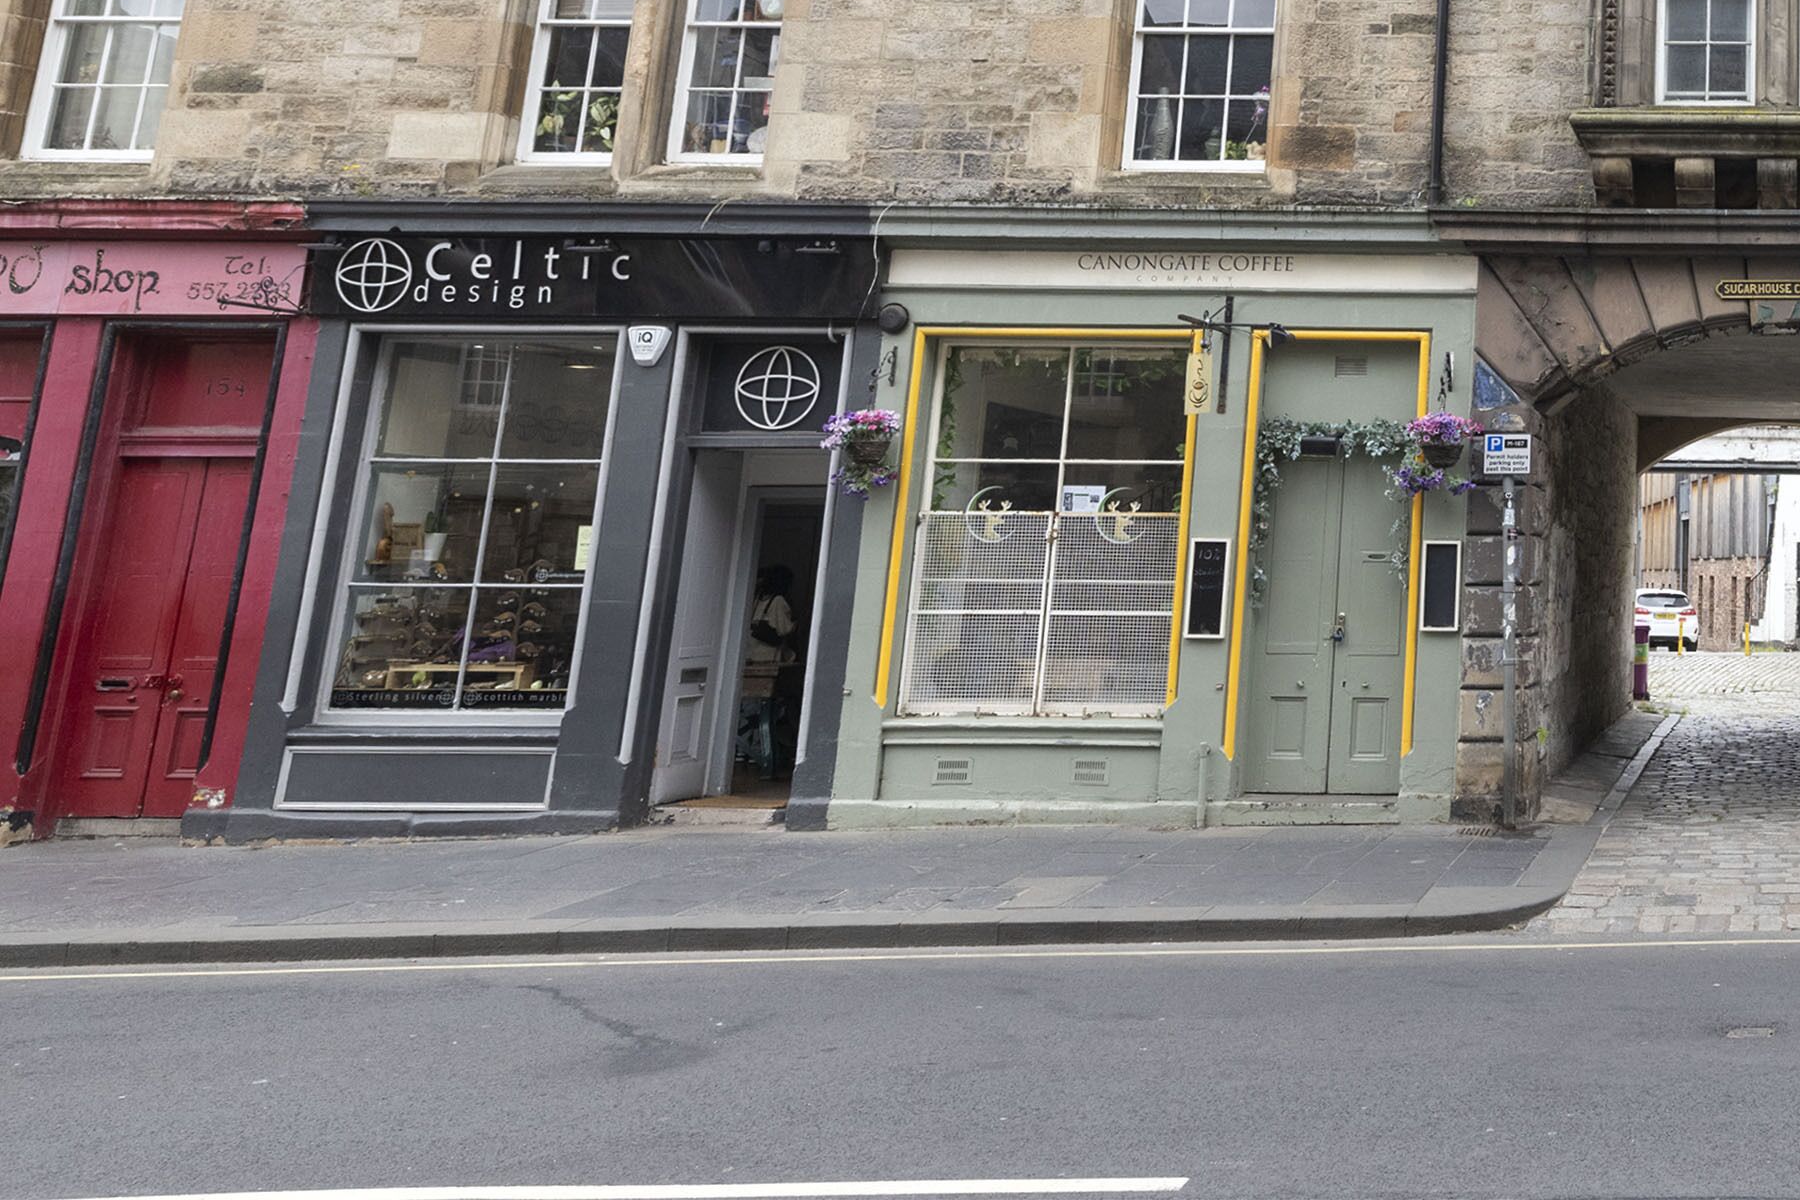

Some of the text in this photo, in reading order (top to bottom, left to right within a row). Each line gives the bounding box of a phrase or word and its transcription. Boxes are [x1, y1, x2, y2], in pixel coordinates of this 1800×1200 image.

[224, 256, 271, 275] Tel:
[425, 240, 630, 281] Celtic
[1078, 254, 1294, 272] CANONGATE COFFEE
[65, 250, 160, 312] shop
[1136, 274, 1234, 283] COMPANY
[413, 278, 552, 308] design
[1724, 283, 1792, 294] SUGARHOUSE
[1491, 438, 1501, 450] P
[349, 692, 399, 703] Sterling
